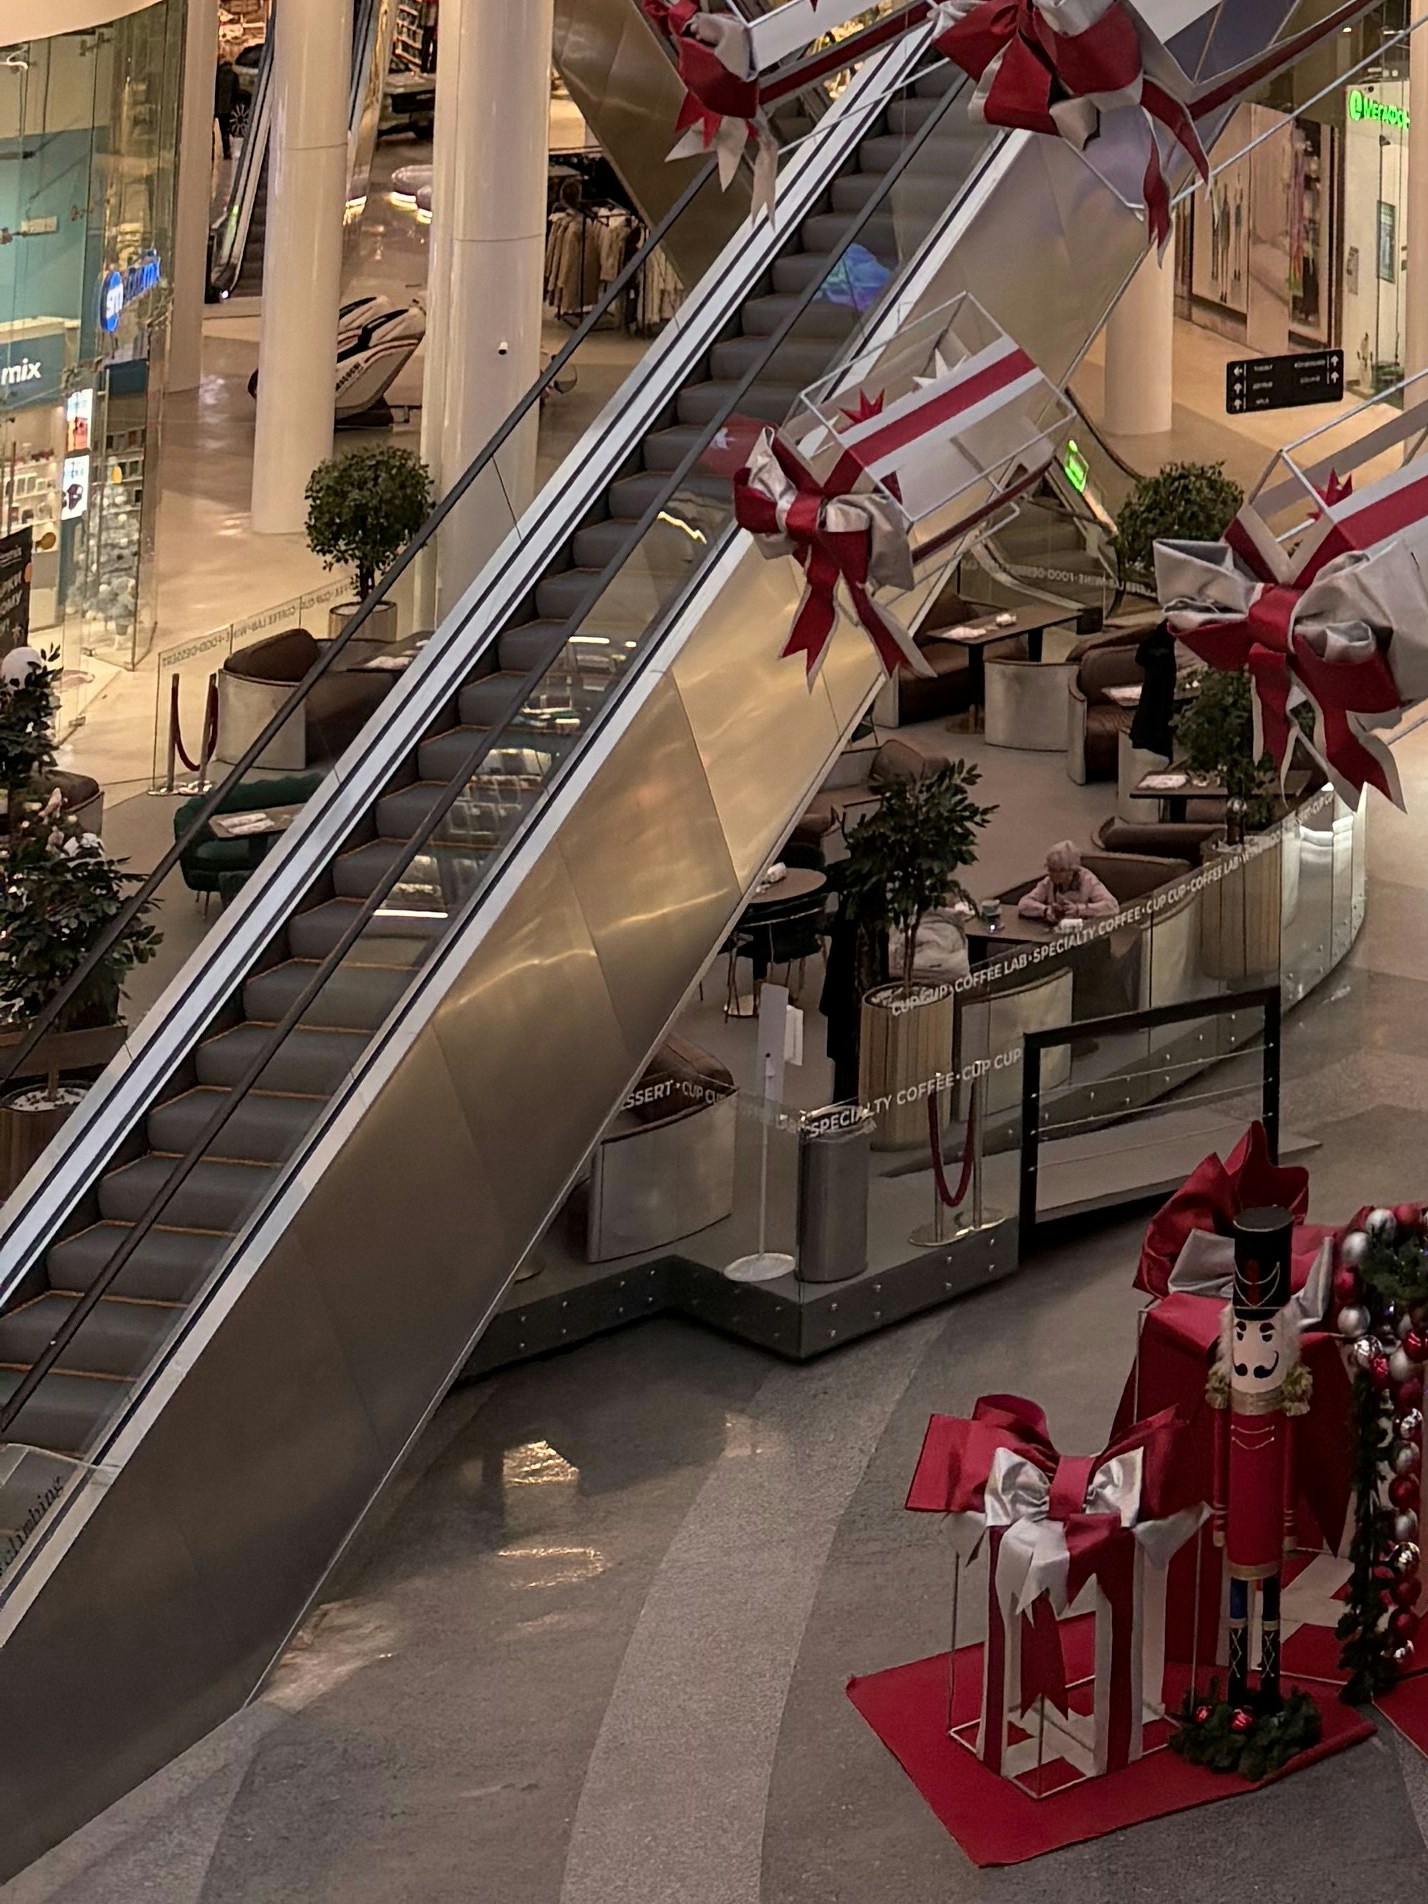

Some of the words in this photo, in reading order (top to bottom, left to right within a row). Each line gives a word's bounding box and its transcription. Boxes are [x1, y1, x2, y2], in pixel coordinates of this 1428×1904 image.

[954, 963, 1002, 993] COFFEE
[1003, 953, 1028, 978] LAB
[1032, 927, 1098, 964] SPECIALTY
[1098, 904, 1142, 936] COFFEE
[1144, 894, 1166, 915] CUP
[1168, 883, 1187, 904] CUP
[1190, 864, 1223, 893] COFFEE
[808, 1094, 893, 1138] SPECIALTY
[895, 1071, 955, 1105] COFFEE
[962, 1059, 992, 1081] CUP
[994, 1048, 1023, 1070] CUP
